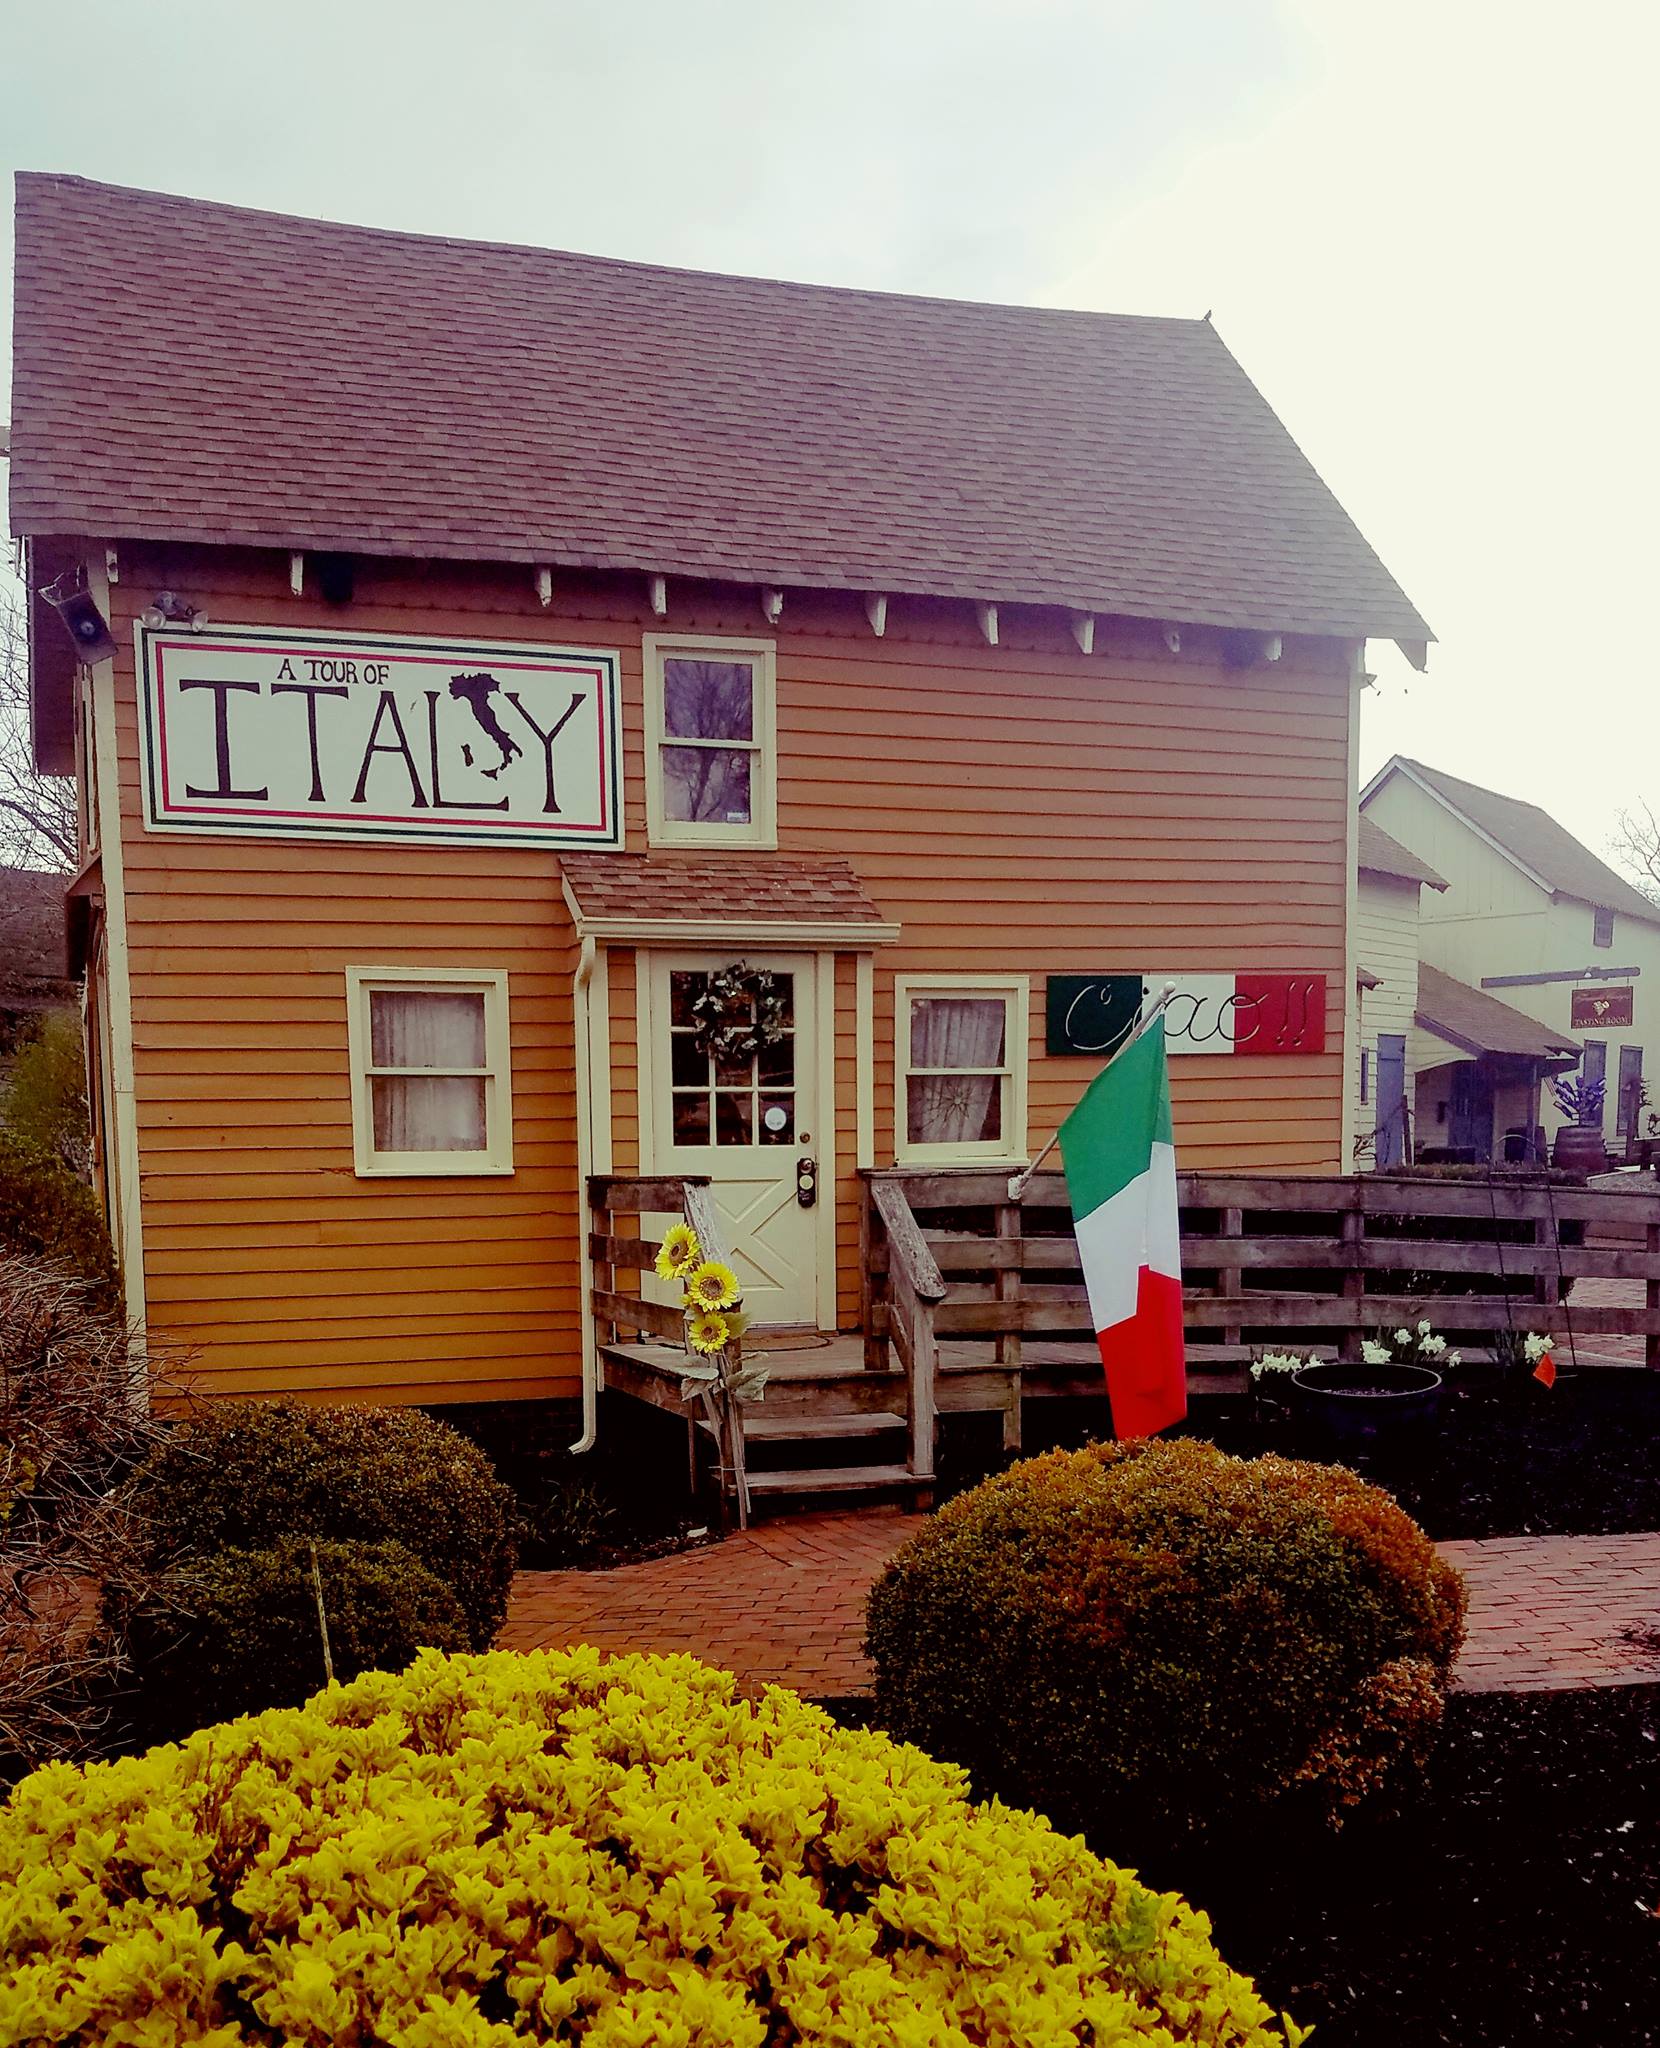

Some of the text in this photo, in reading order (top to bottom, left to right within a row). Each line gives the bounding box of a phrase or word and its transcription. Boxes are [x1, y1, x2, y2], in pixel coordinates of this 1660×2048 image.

[277, 658, 390, 686] A TOUR OF
[179, 679, 587, 813] ITALY
